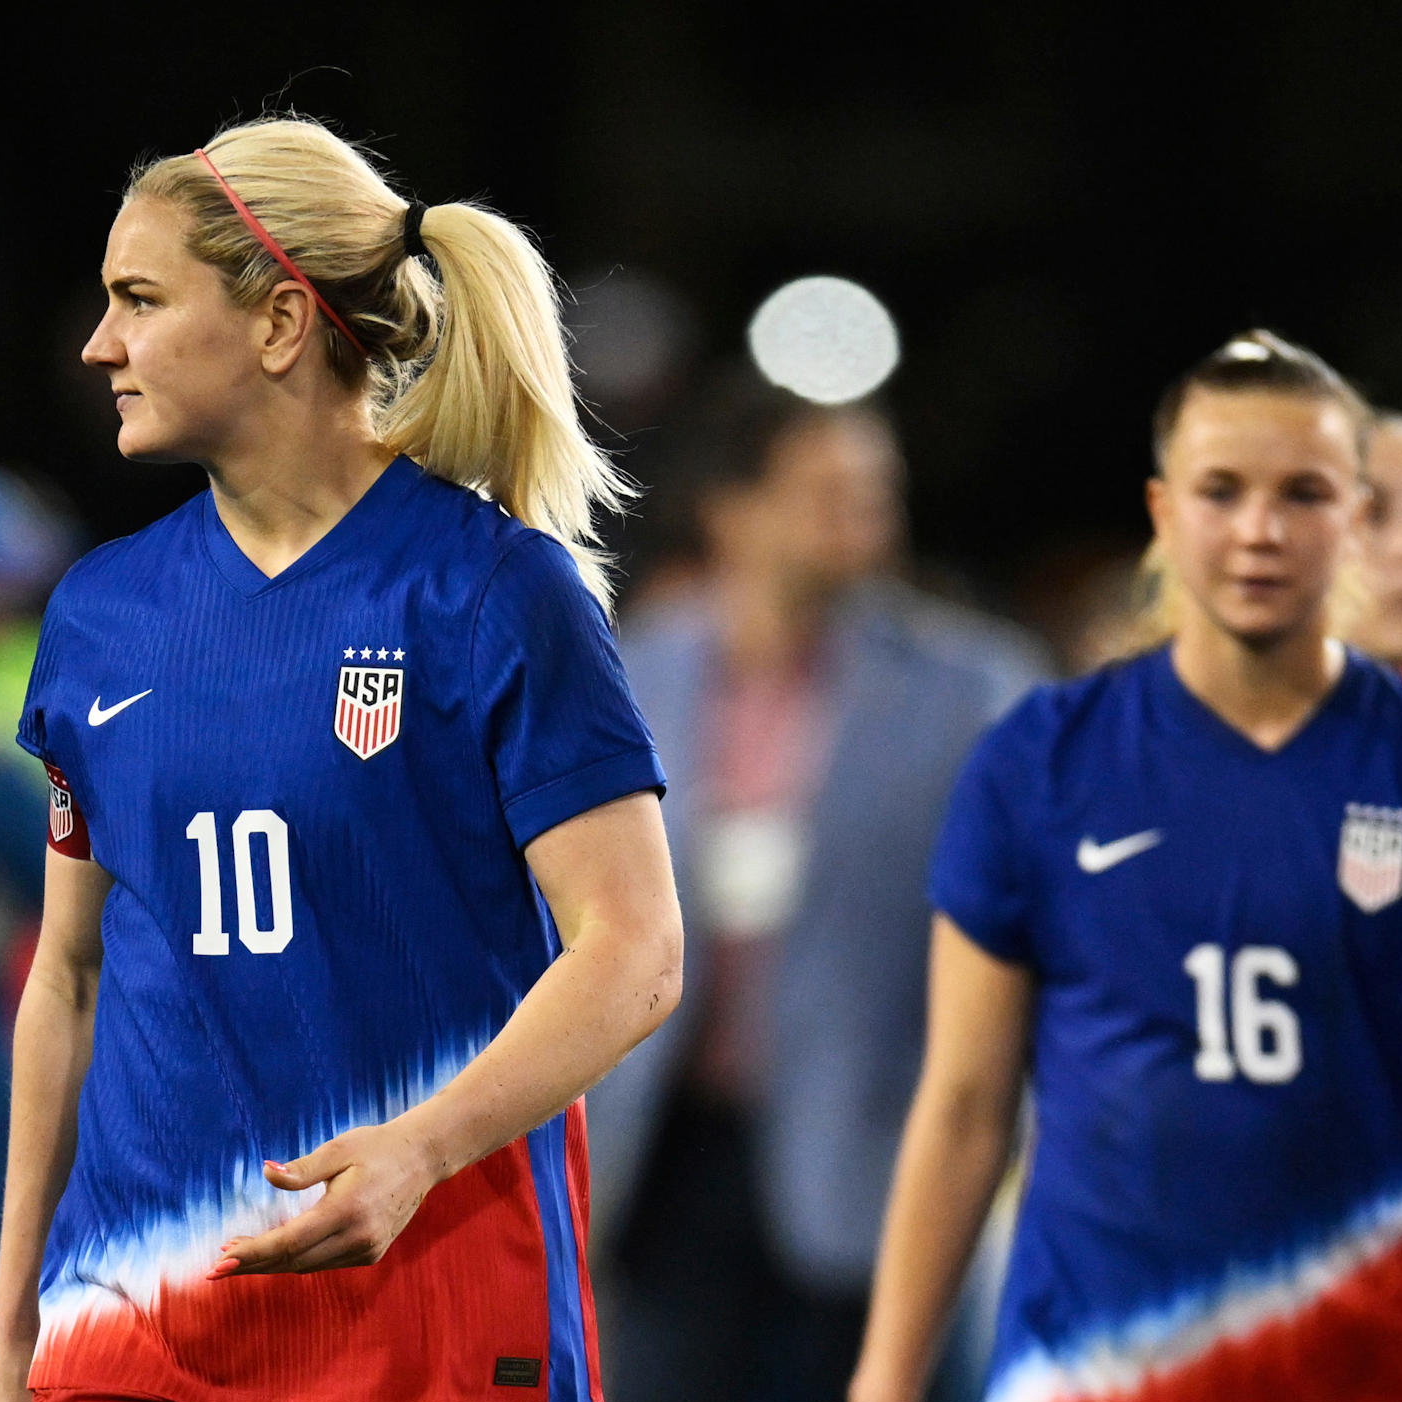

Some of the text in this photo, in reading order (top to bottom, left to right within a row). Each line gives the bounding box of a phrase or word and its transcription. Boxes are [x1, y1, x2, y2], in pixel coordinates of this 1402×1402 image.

[343, 671, 398, 706] USA
[50, 784, 69, 808] SA
[186, 808, 294, 956] 10
[1184, 943, 1302, 1085] 16
